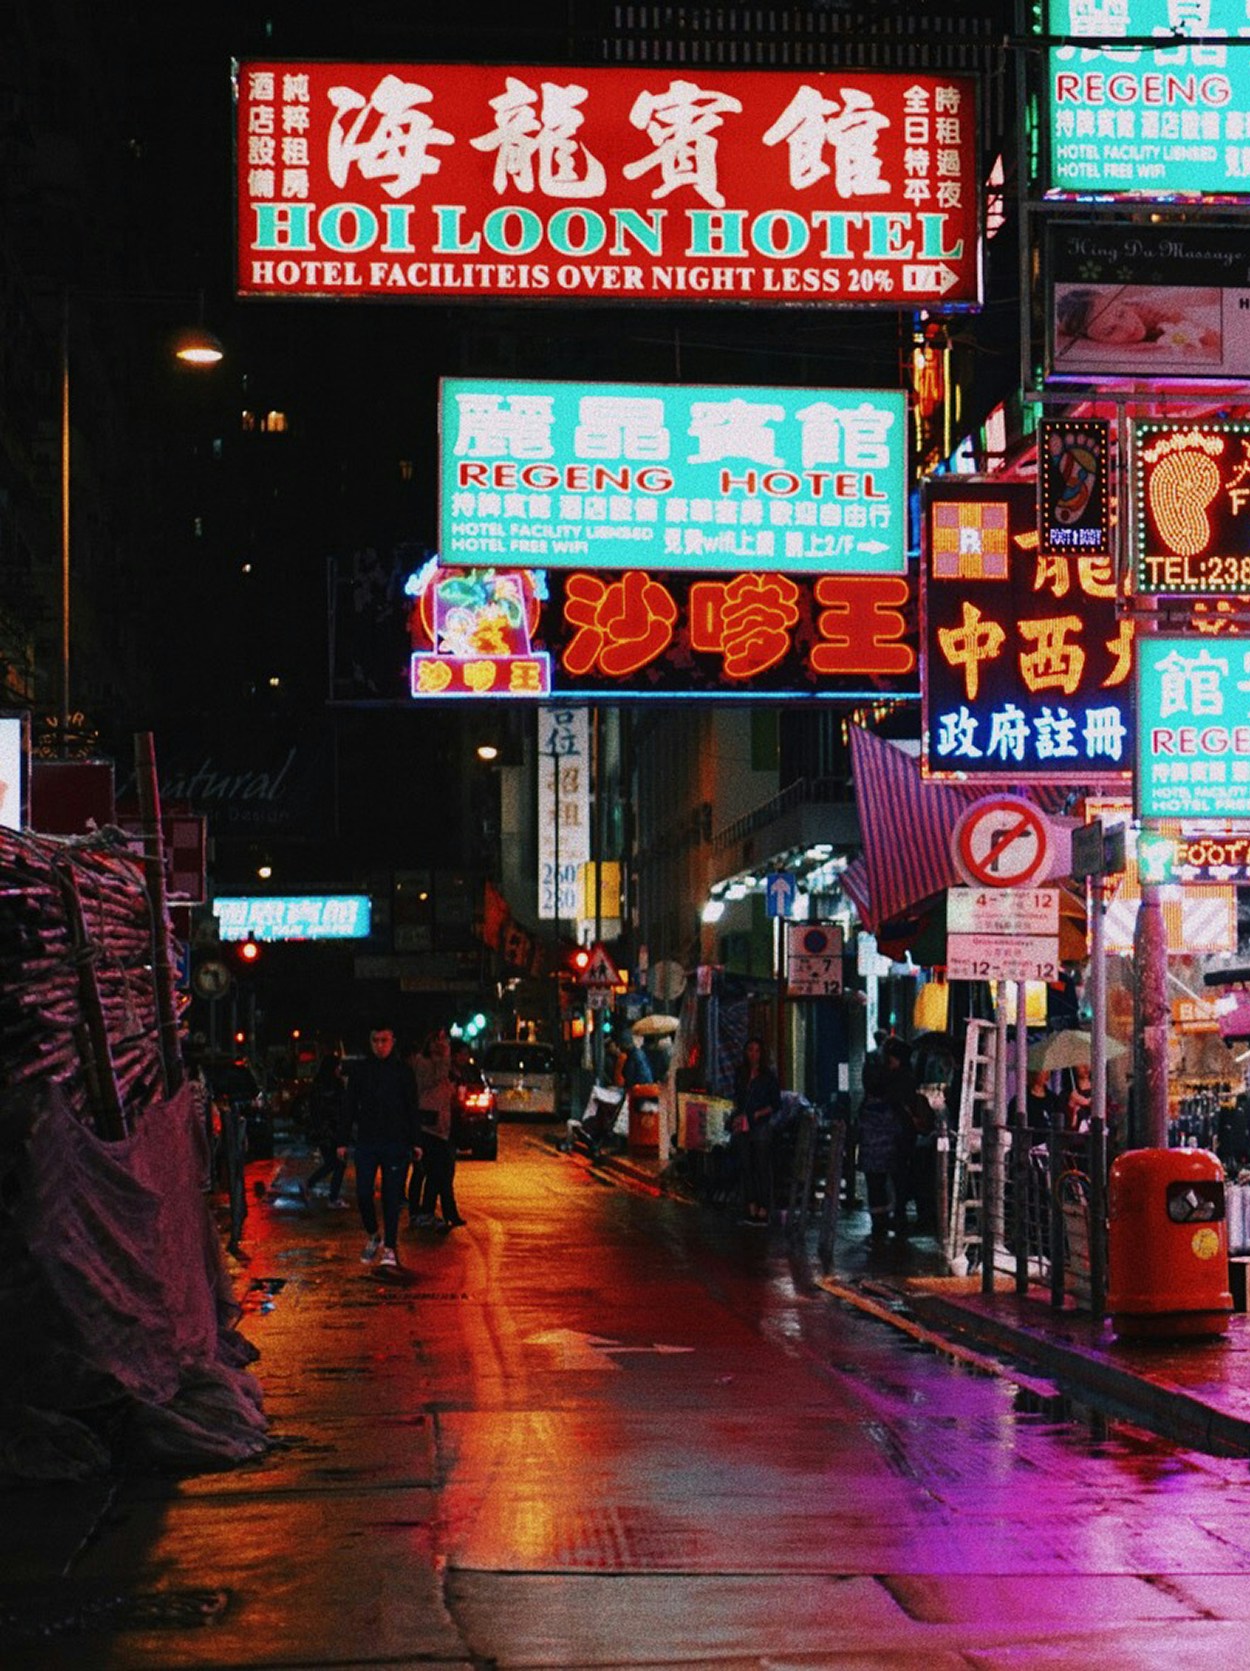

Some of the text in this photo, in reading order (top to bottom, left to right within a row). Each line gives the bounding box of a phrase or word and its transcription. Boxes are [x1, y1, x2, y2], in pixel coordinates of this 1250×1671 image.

[1055, 72, 1231, 106] REGENG
[249, 72, 275, 198] 酒店設備
[327, 74, 892, 209] 海龍賓館
[1057, 145, 1100, 160] HOTEL
[1057, 162, 1100, 177] HOTEL
[1103, 163, 1132, 178] FREE
[250, 202, 965, 260] HOI LOON HOTEL
[251, 261, 362, 285] HOTEL
[370, 262, 549, 288] FACILITEIS
[557, 265, 645, 291] OVER
[651, 266, 755, 292] NIGHT
[763, 268, 841, 292] LESS
[848, 268, 893, 293] 20%
[452, 393, 896, 468] 麗晶賓館
[458, 462, 889, 499] REGENG HOTEL
[451, 522, 504, 537] HOTEL
[510, 524, 582, 538] FACILITY
[451, 538, 504, 553] HOTEL
[510, 540, 548, 554] FREE
[938, 703, 1127, 762] 政府註冊
[1173, 844, 1239, 867] FOOT
